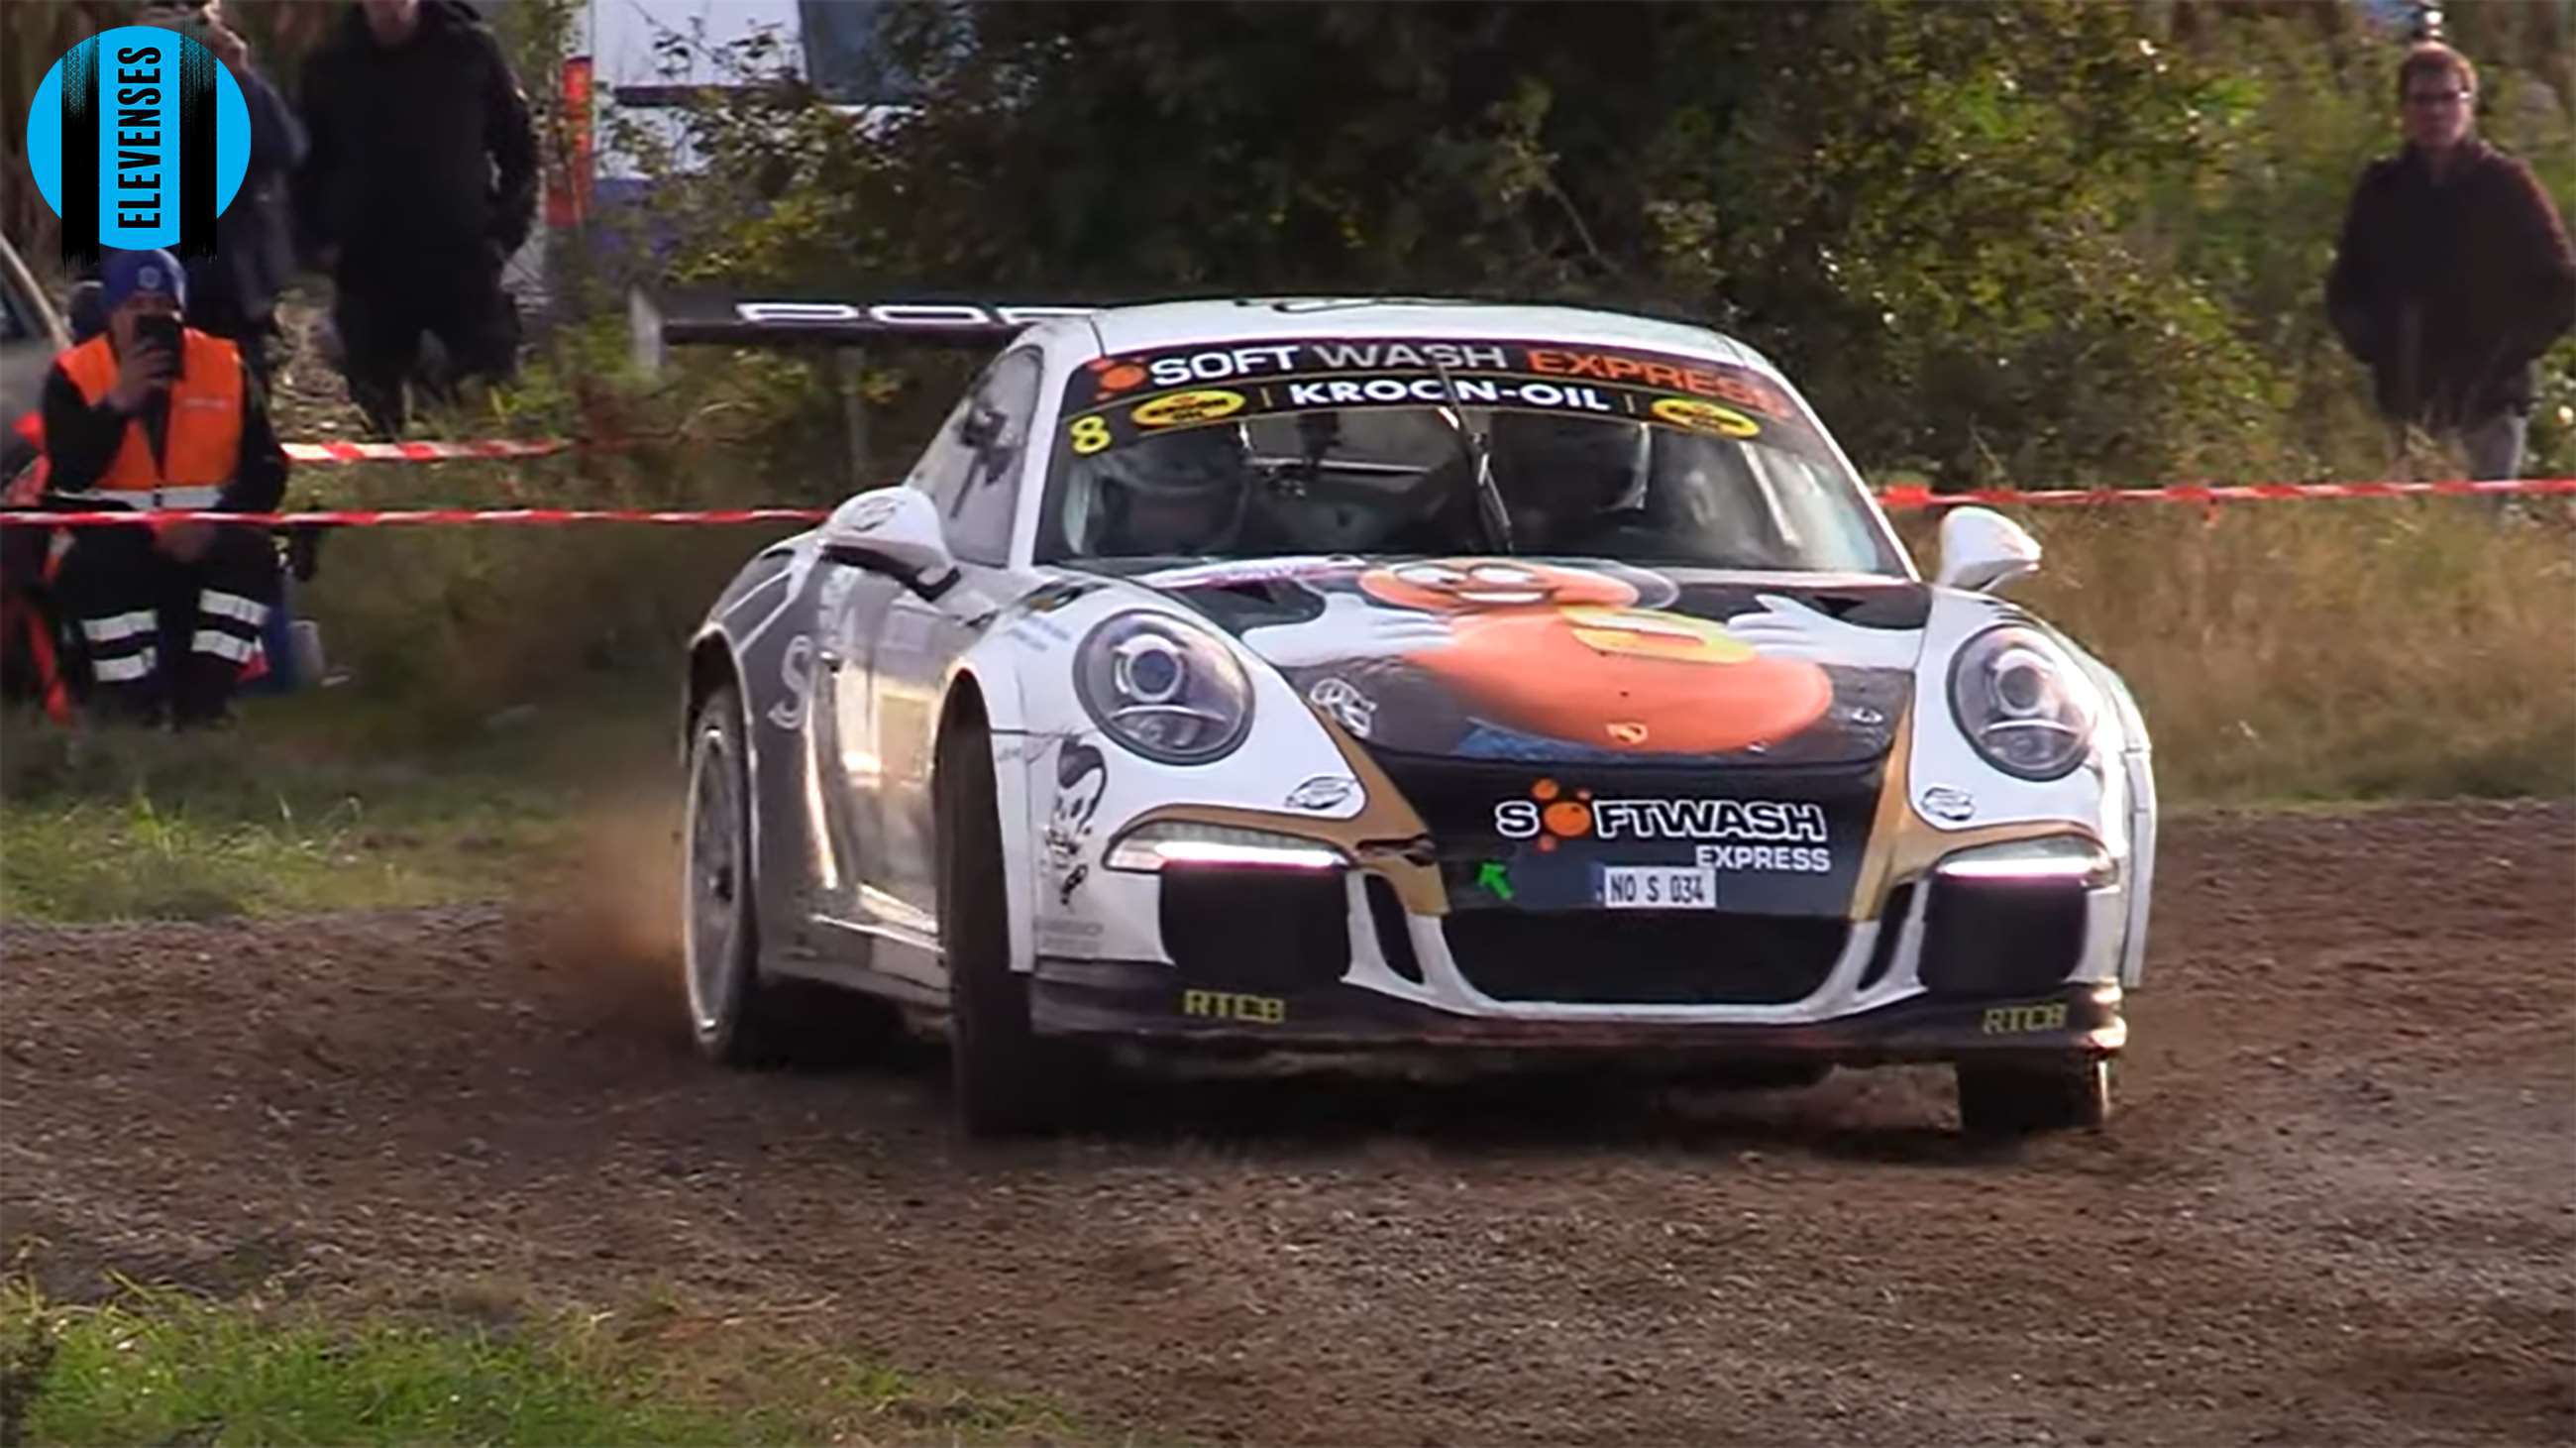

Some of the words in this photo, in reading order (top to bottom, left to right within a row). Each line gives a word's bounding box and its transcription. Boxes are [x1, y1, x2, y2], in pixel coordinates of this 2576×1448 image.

[1149, 345, 1300, 387] SOFT
[1312, 343, 1509, 369] WASH
[1070, 415, 1111, 455] 8
[1695, 844, 1832, 873] EXPRESS
[1646, 875, 1661, 903] S
